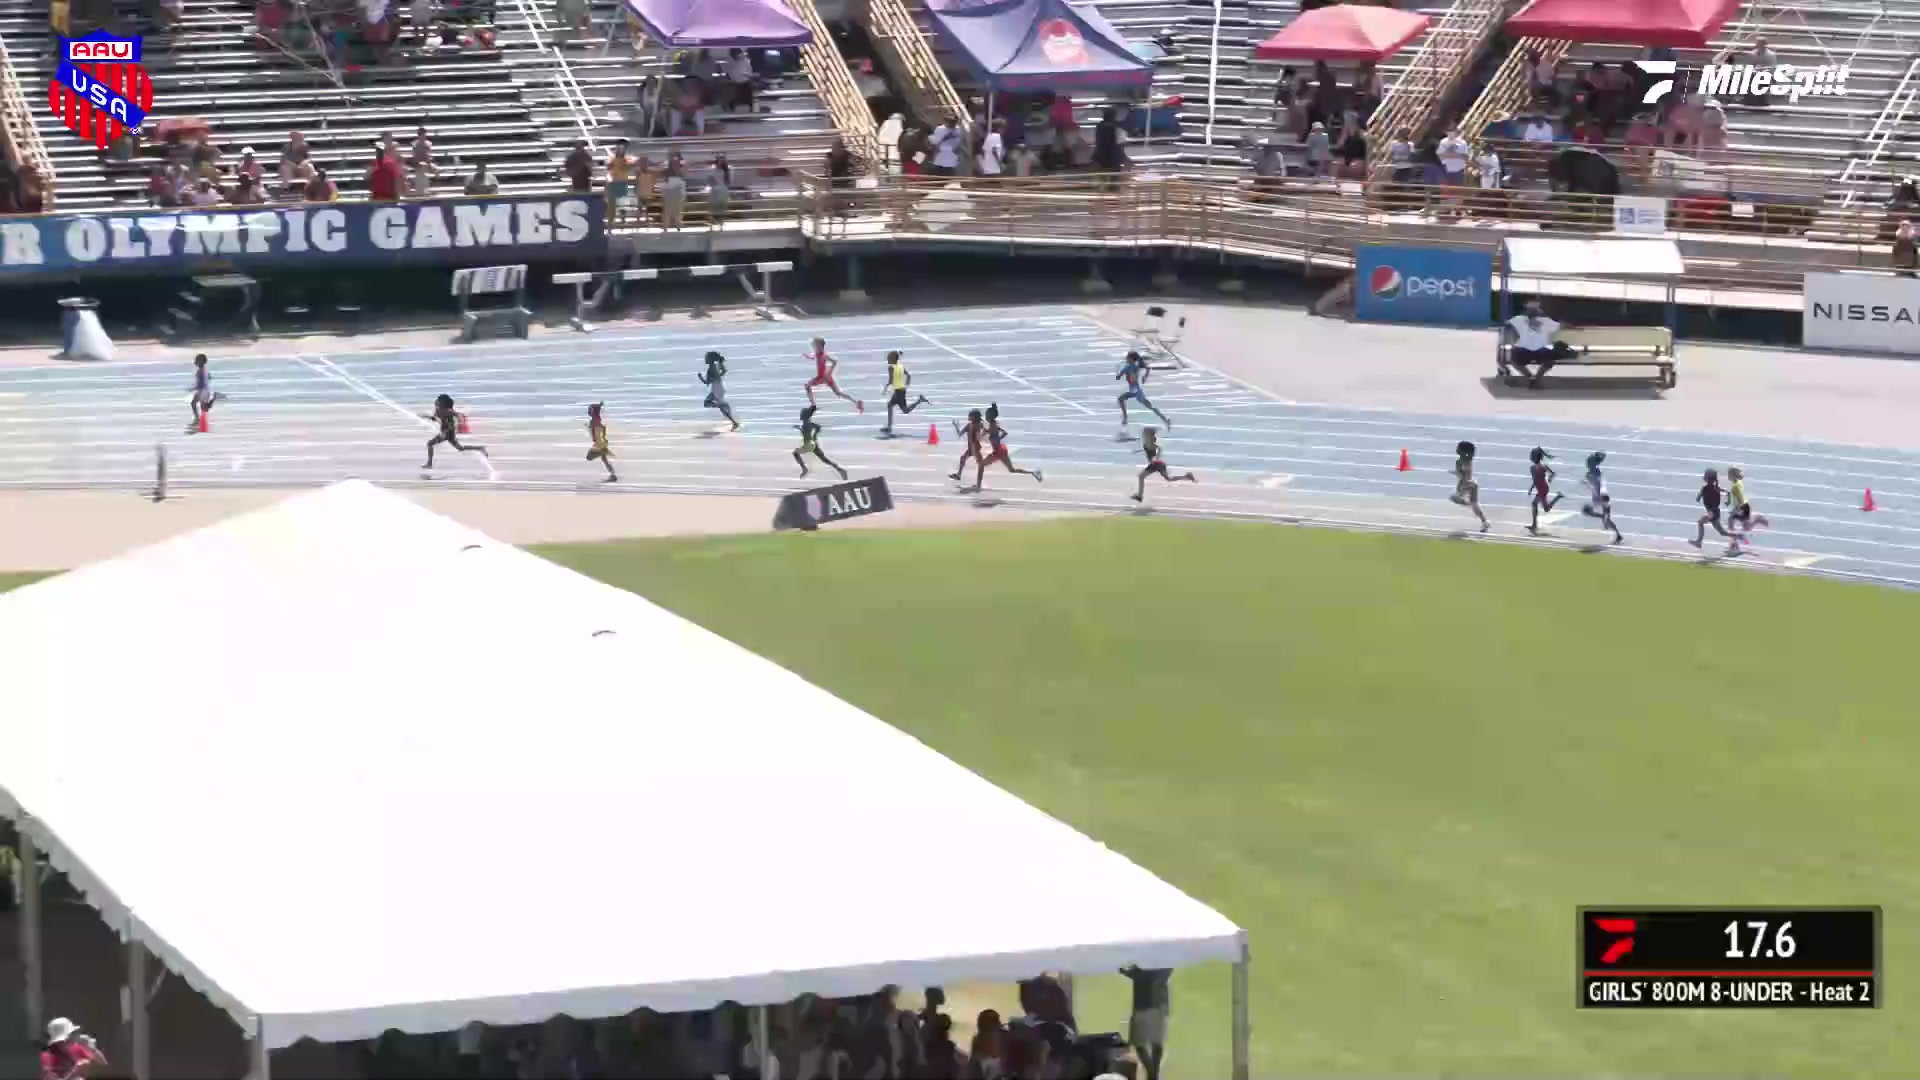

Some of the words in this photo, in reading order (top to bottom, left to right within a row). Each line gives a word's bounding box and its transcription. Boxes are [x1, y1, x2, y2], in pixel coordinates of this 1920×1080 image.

[65, 207, 347, 262] OLYMPIC
[369, 200, 590, 250] GAMES
[1406, 275, 1475, 300] pepsi
[1813, 301, 1920, 325] NISSA
[828, 486, 872, 516] AAU
